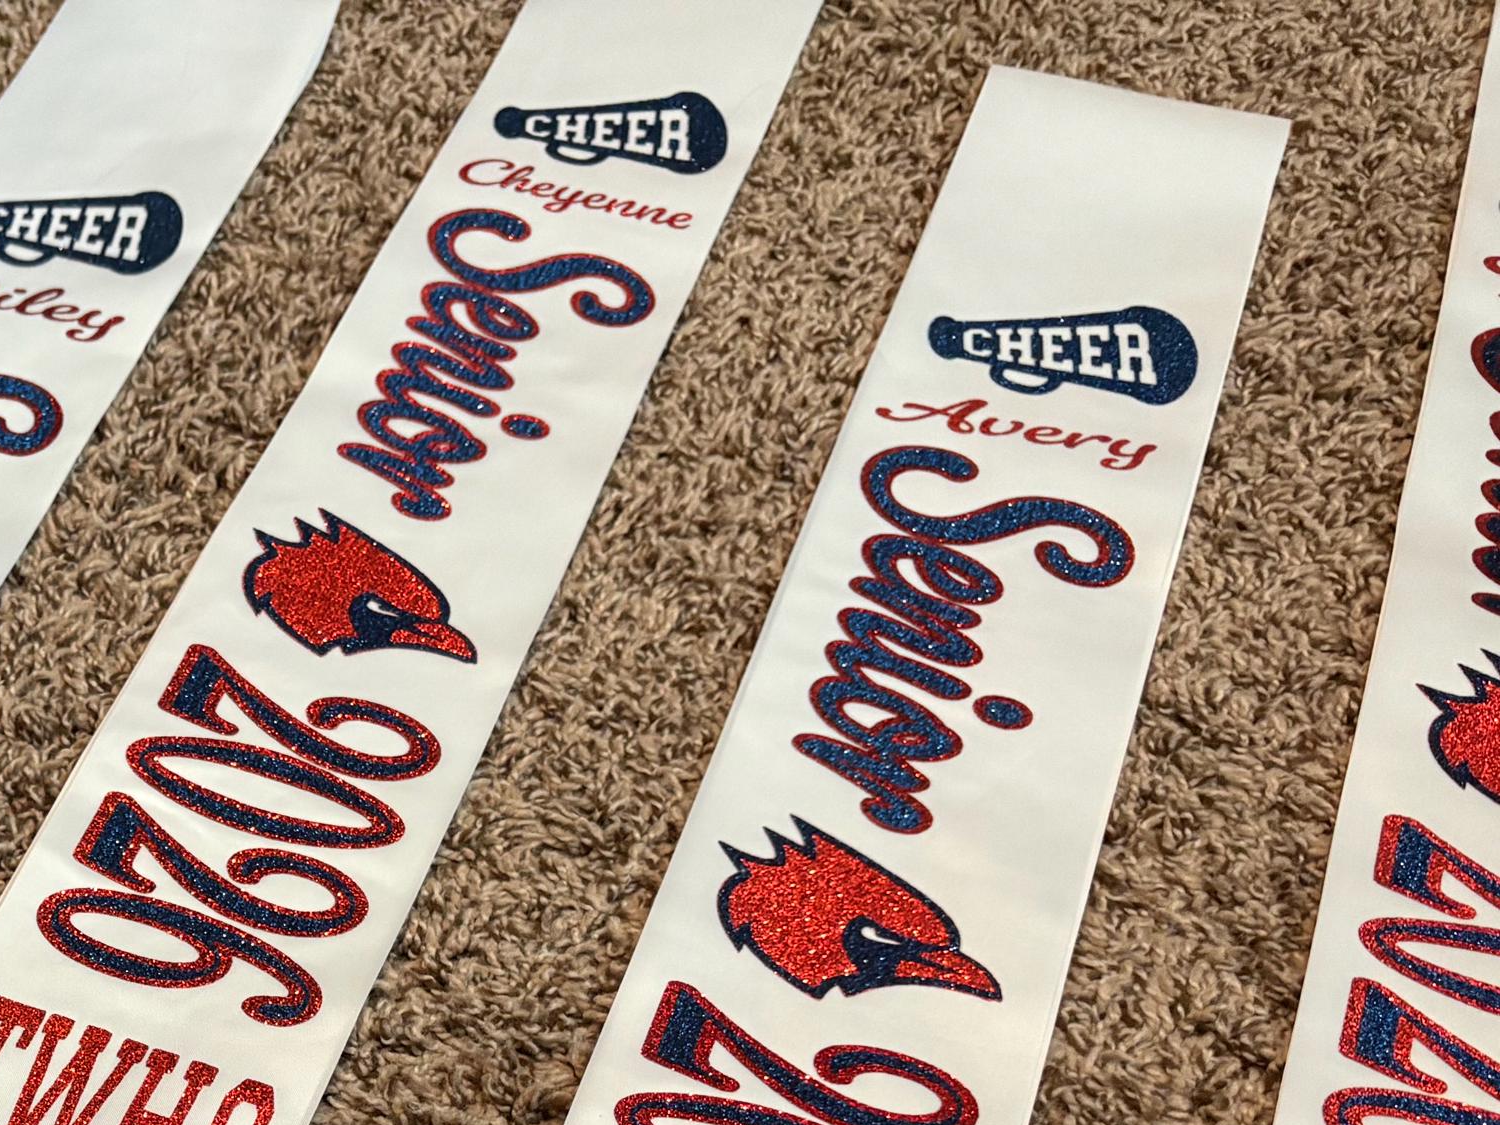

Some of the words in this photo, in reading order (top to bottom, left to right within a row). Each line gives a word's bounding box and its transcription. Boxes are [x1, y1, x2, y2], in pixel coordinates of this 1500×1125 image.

[524, 109, 692, 161] CHEER
[458, 158, 693, 230] Cheyenne
[337, 208, 656, 521] Senior
[962, 322, 1156, 385] CHEER
[875, 398, 1158, 470] Avery
[792, 445, 1135, 835] Senior
[36, 643, 442, 1027] 2026
